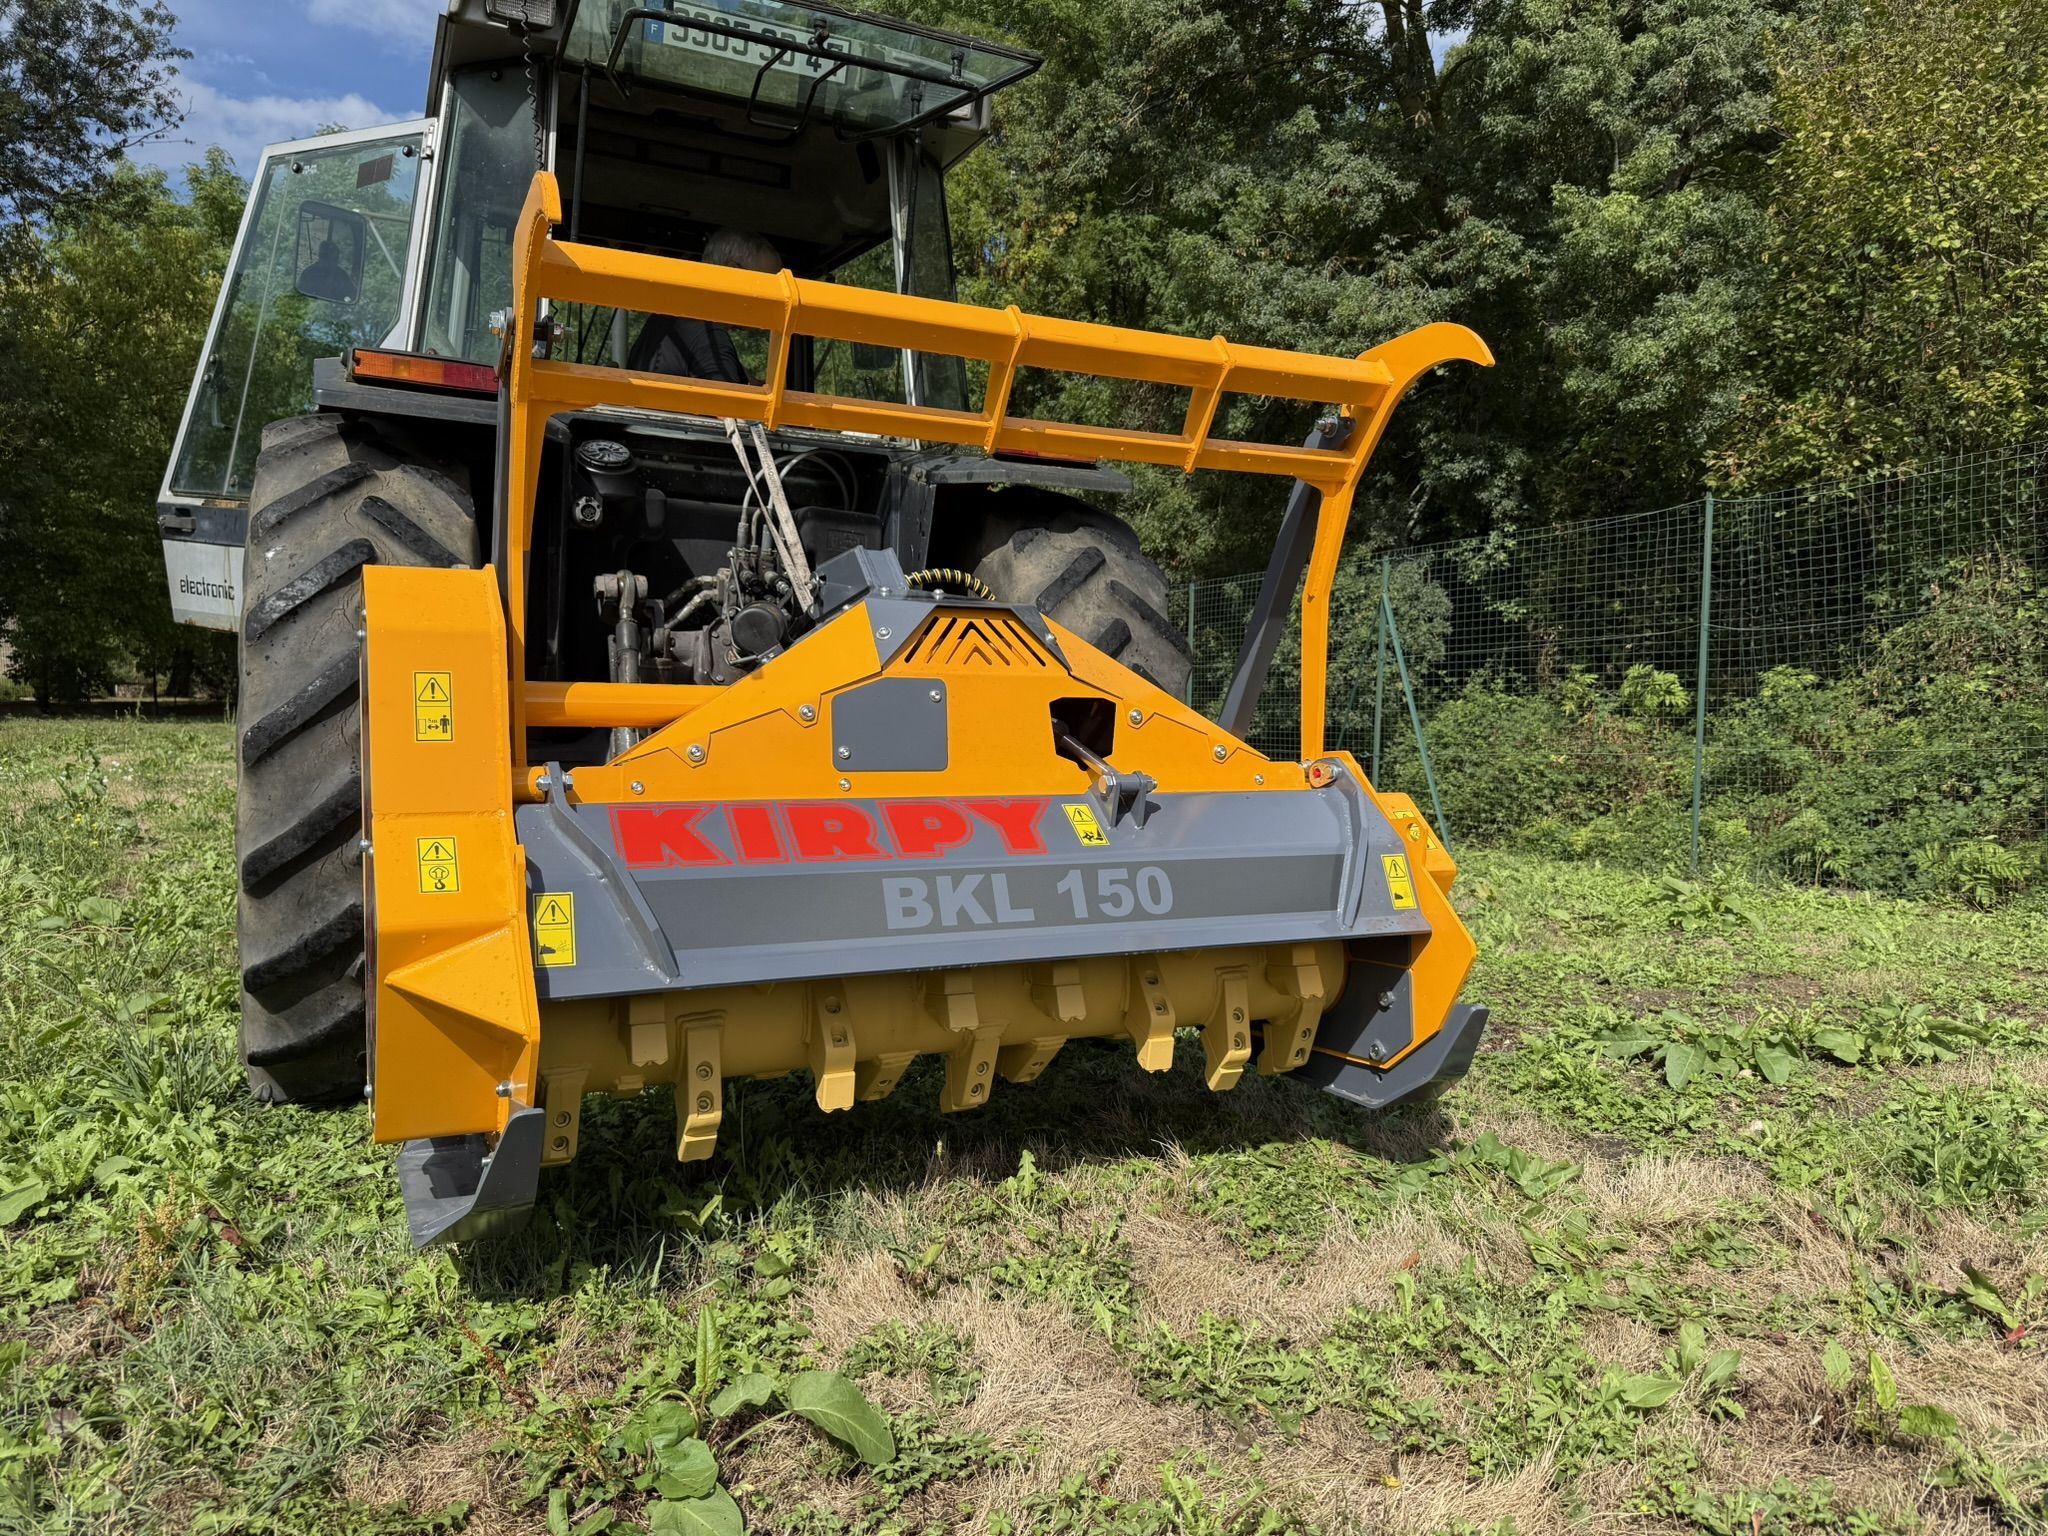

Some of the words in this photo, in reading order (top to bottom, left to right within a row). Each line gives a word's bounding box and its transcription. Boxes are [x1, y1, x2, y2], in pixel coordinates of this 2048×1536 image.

[650, 23, 659, 34] F
[180, 574, 235, 601] electronic
[608, 797, 1052, 870] KIRPY
[882, 873, 1035, 930] BKL
[1056, 866, 1174, 919] 150
